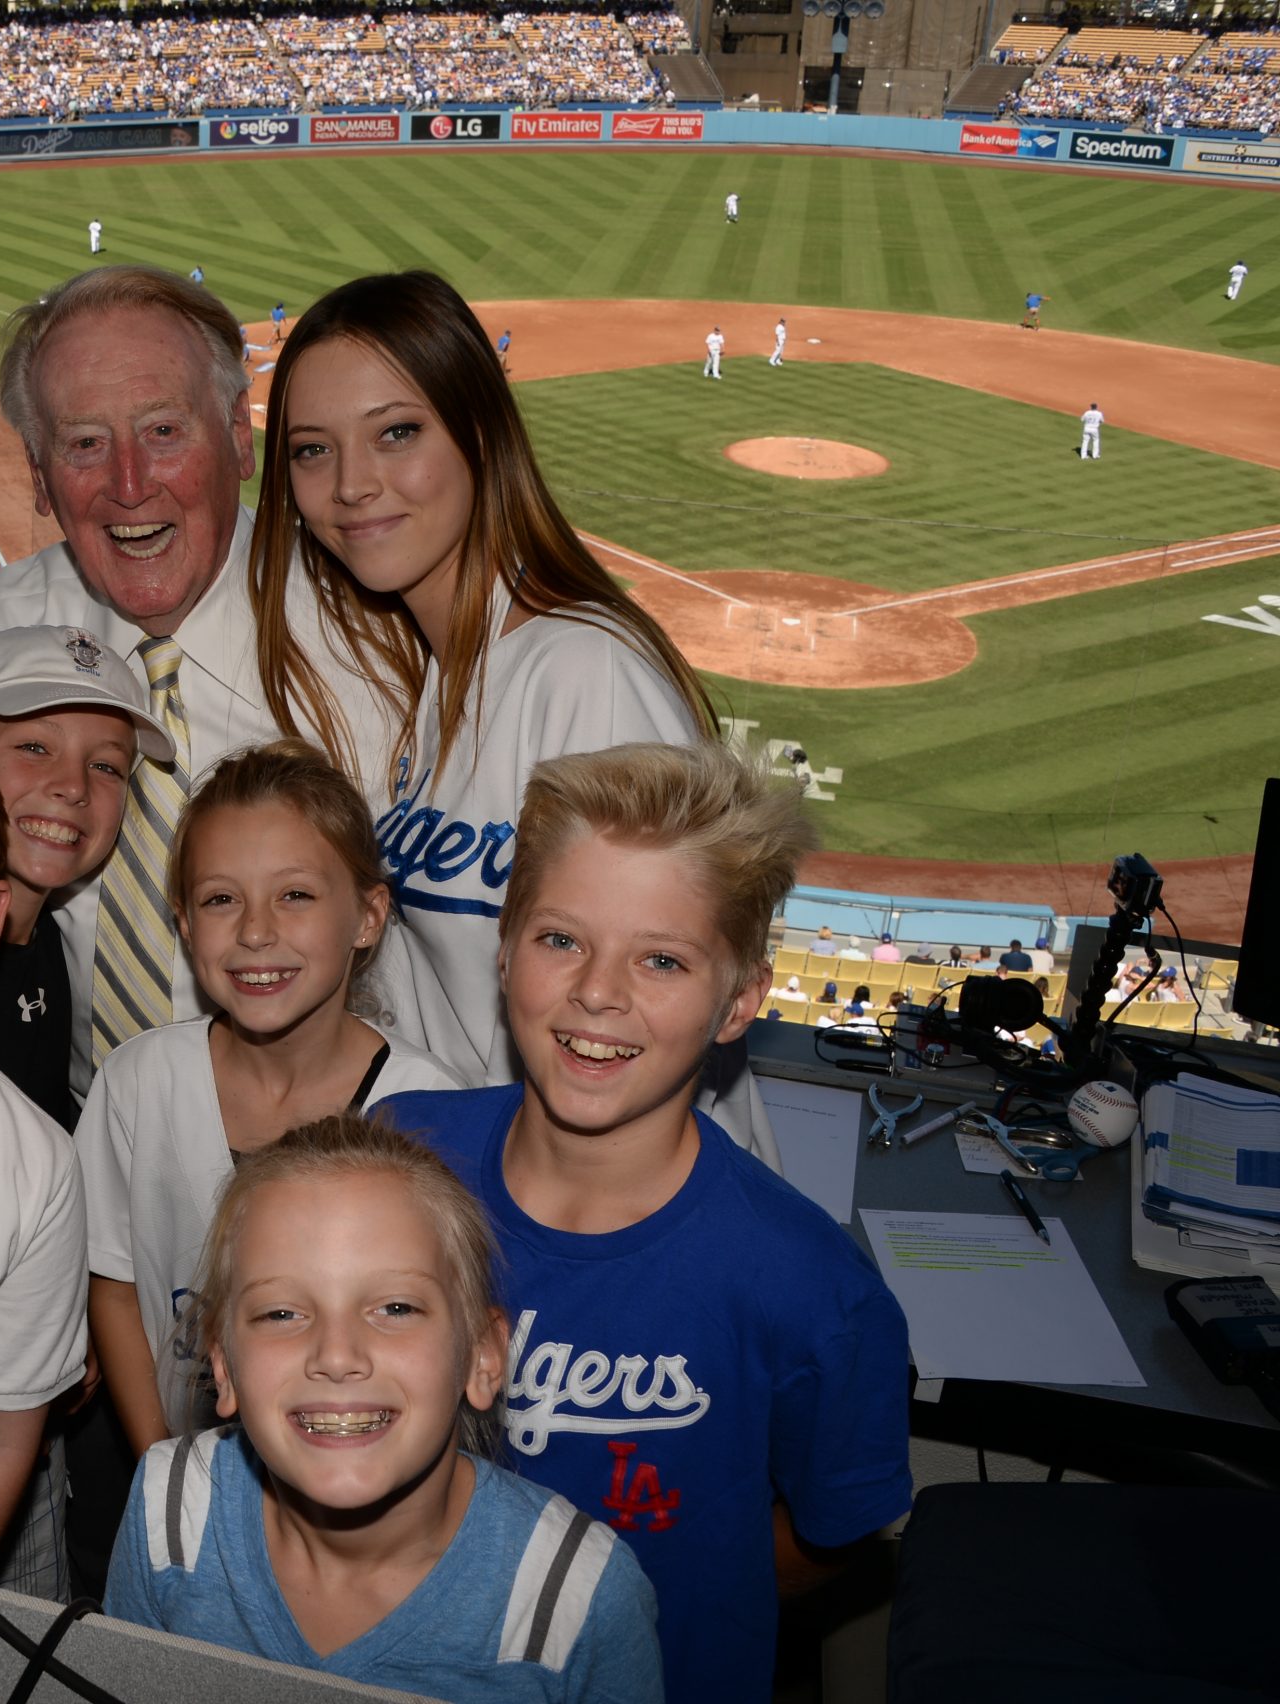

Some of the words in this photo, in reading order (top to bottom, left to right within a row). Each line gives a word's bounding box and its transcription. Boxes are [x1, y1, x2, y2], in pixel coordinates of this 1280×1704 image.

[315, 122, 338, 132] SAN
[347, 120, 394, 131] MANUEL
[456, 119, 482, 136] LG
[513, 118, 536, 135] Fly
[539, 118, 600, 132] Emirates
[962, 133, 984, 145] Bank
[984, 134, 995, 146] of
[995, 135, 1032, 149] America
[1075, 136, 1162, 160] Spectrum
[1201, 153, 1242, 163] ESTRELLA
[1243, 156, 1278, 166] JALISCO
[505, 1309, 711, 1456] gers
